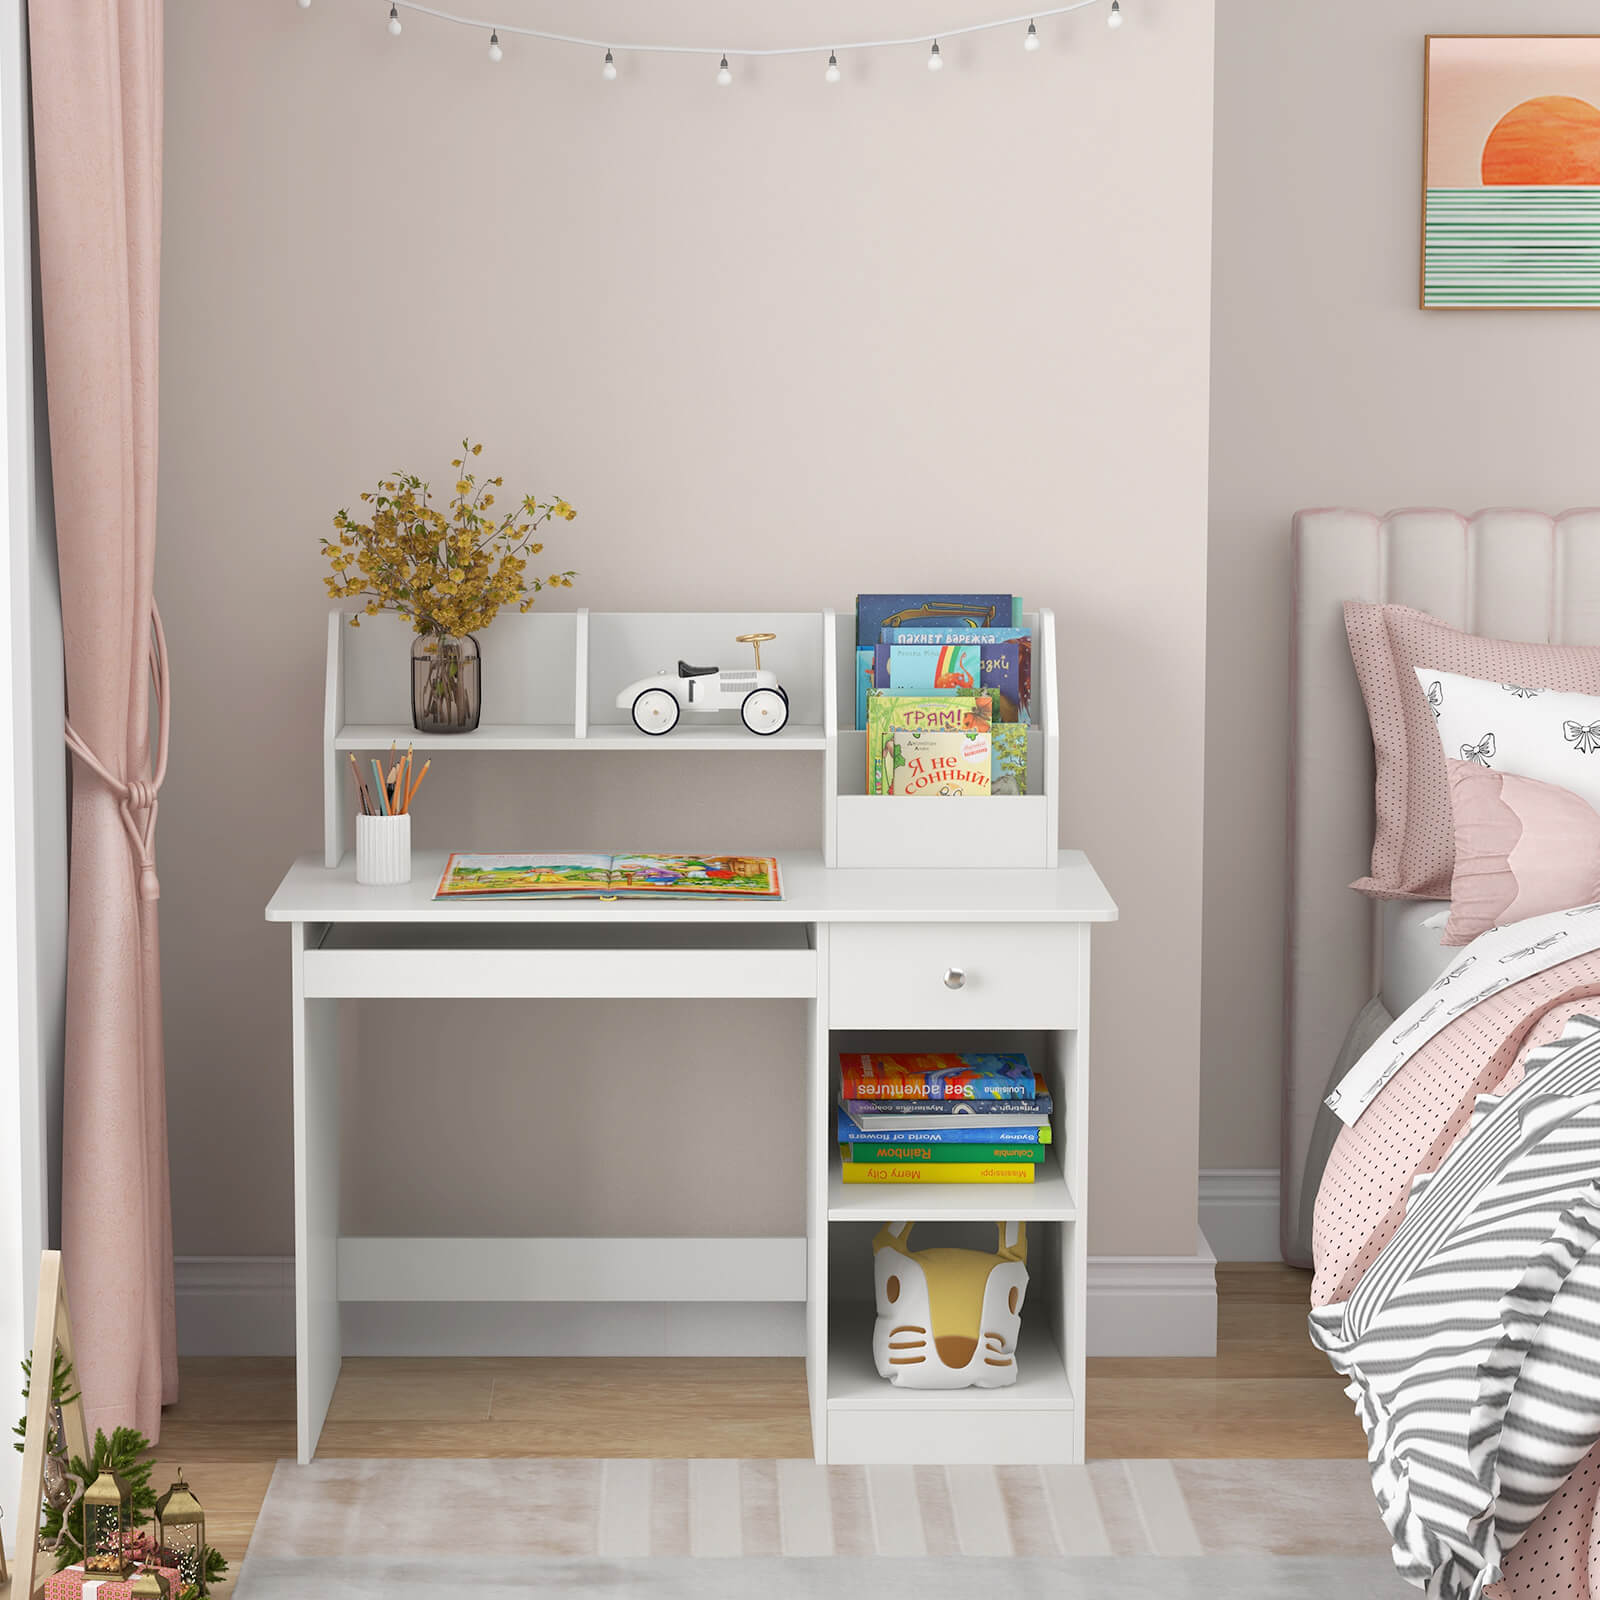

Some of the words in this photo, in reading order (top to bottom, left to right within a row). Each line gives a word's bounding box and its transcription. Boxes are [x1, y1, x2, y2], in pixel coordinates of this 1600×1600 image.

[904, 709, 961, 726] ТРЯМ!
[908, 757, 925, 778] Я
[930, 756, 957, 770] не
[905, 769, 990, 795] сонный!
[858, 1084, 940, 1097] adventures
[944, 1084, 974, 1097] Sea
[984, 1085, 1025, 1095] Louisiana
[848, 1133, 890, 1141] flowers
[893, 1133, 905, 1141] of
[908, 1133, 942, 1141] World
[999, 1133, 1035, 1141] Sydney
[876, 1148, 931, 1160] Rainbow
[993, 1149, 1033, 1157] Columbia
[867, 1168, 888, 1180] City
[891, 1168, 921, 1179] Merry
